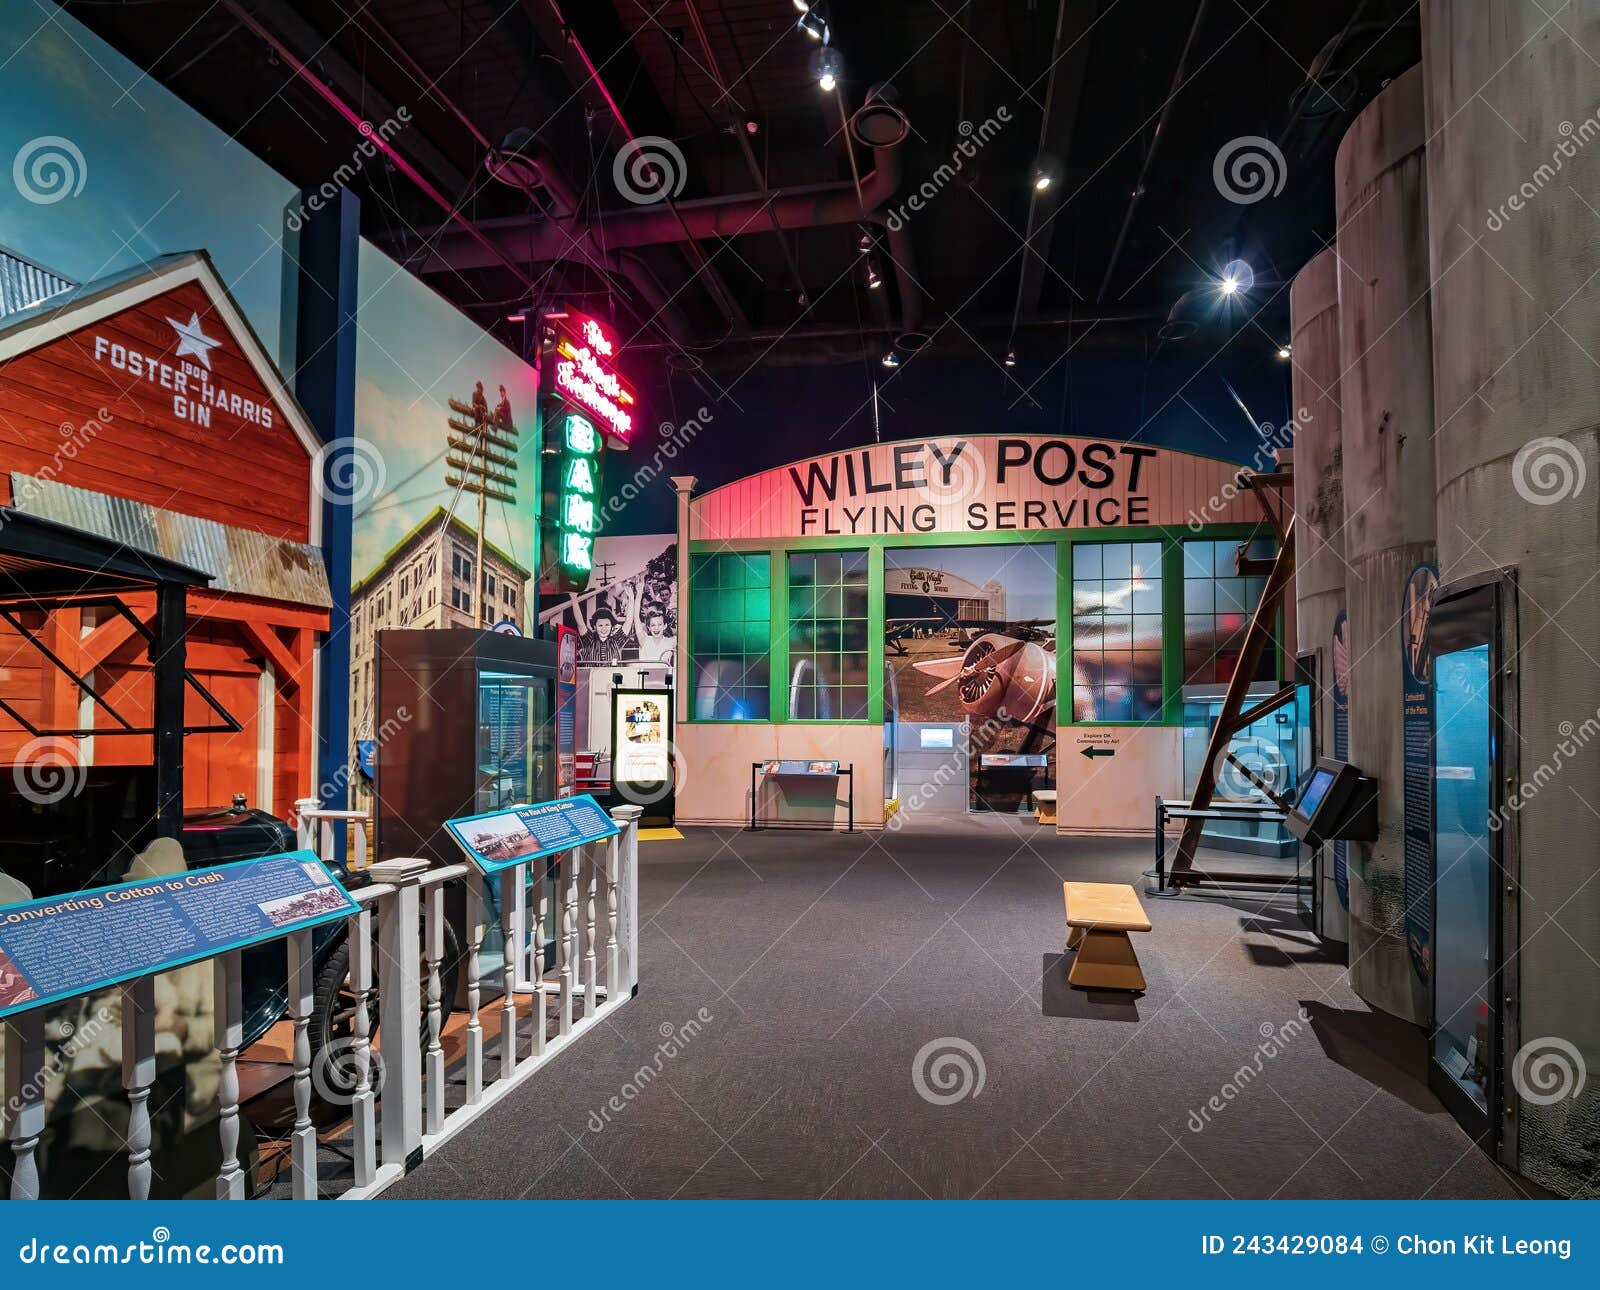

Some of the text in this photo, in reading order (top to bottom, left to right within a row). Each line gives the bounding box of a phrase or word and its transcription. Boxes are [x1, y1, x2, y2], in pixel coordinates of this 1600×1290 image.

[95, 336, 273, 429] FOSTER-HARRIS
[173, 395, 211, 428] GIN
[564, 414, 595, 571] BANK
[788, 440, 1157, 507] WILEY POST
[801, 497, 1150, 535] FLYING SERVICE
[105, 884, 164, 904] Cotton
[165, 880, 184, 891] to
[186, 871, 224, 887] Cash
